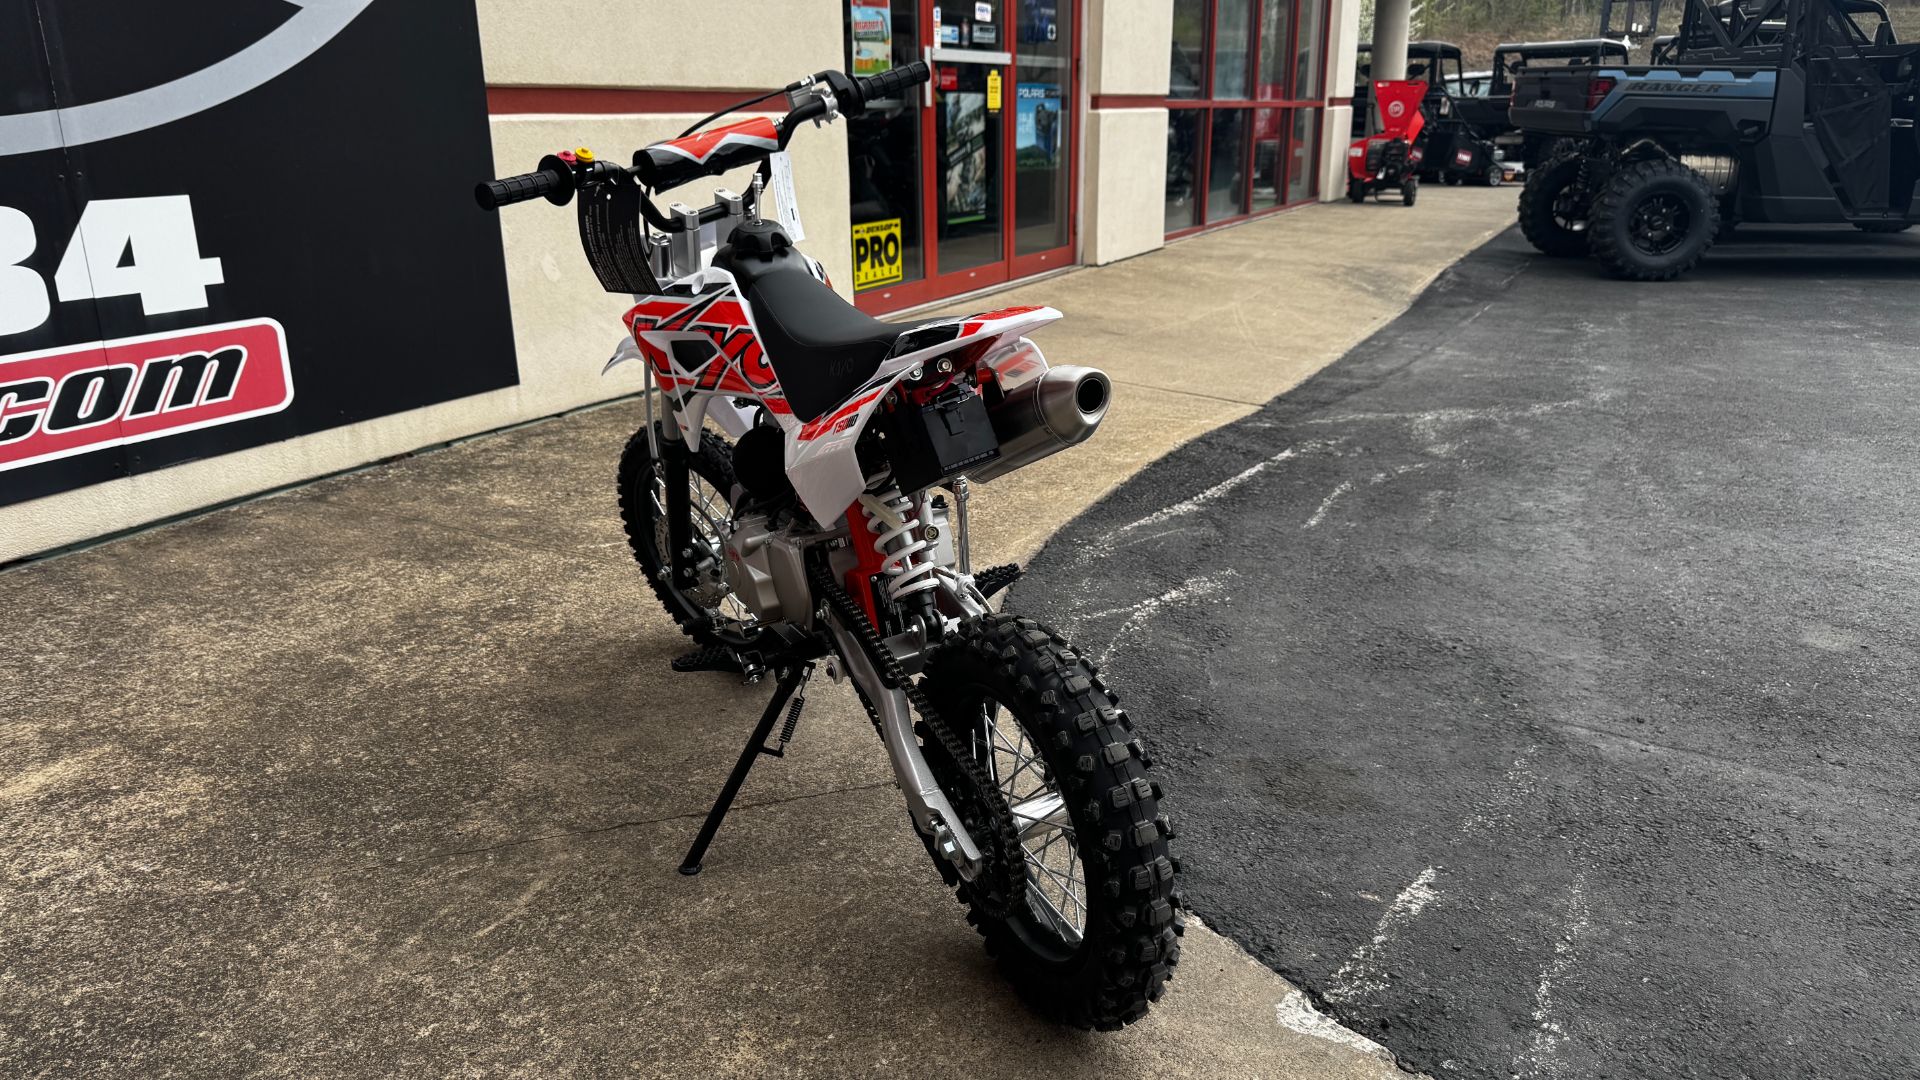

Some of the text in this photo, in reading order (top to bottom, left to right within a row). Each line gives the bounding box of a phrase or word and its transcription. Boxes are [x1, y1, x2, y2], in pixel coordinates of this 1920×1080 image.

[1624, 82, 1722, 93] RANGER
[866, 223, 893, 234] DUNLOP
[855, 232, 899, 272] PRO
[856, 265, 900, 282] DEALER
